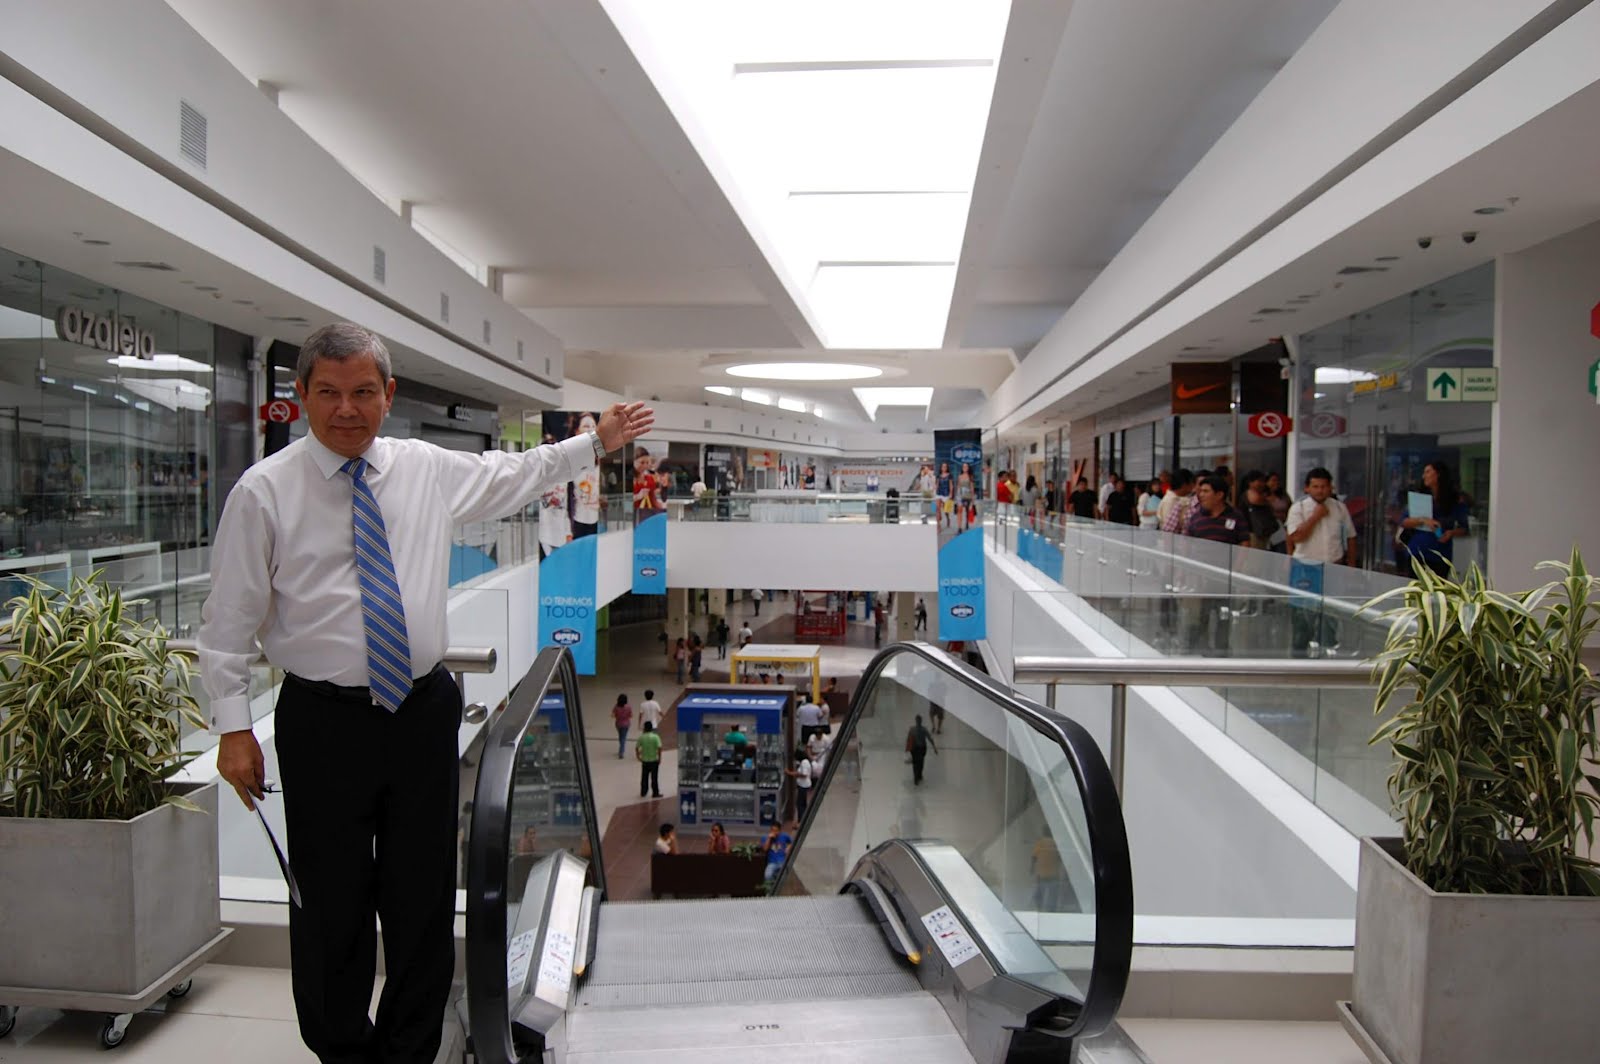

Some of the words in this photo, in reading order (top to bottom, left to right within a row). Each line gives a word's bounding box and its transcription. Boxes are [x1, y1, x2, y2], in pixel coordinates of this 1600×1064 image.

[944, 585, 980, 597] TODO
[554, 596, 593, 606] TENEMOS
[545, 605, 589, 619] TODO
[691, 697, 778, 705] CASIO
[744, 1023, 780, 1031] OTIS
